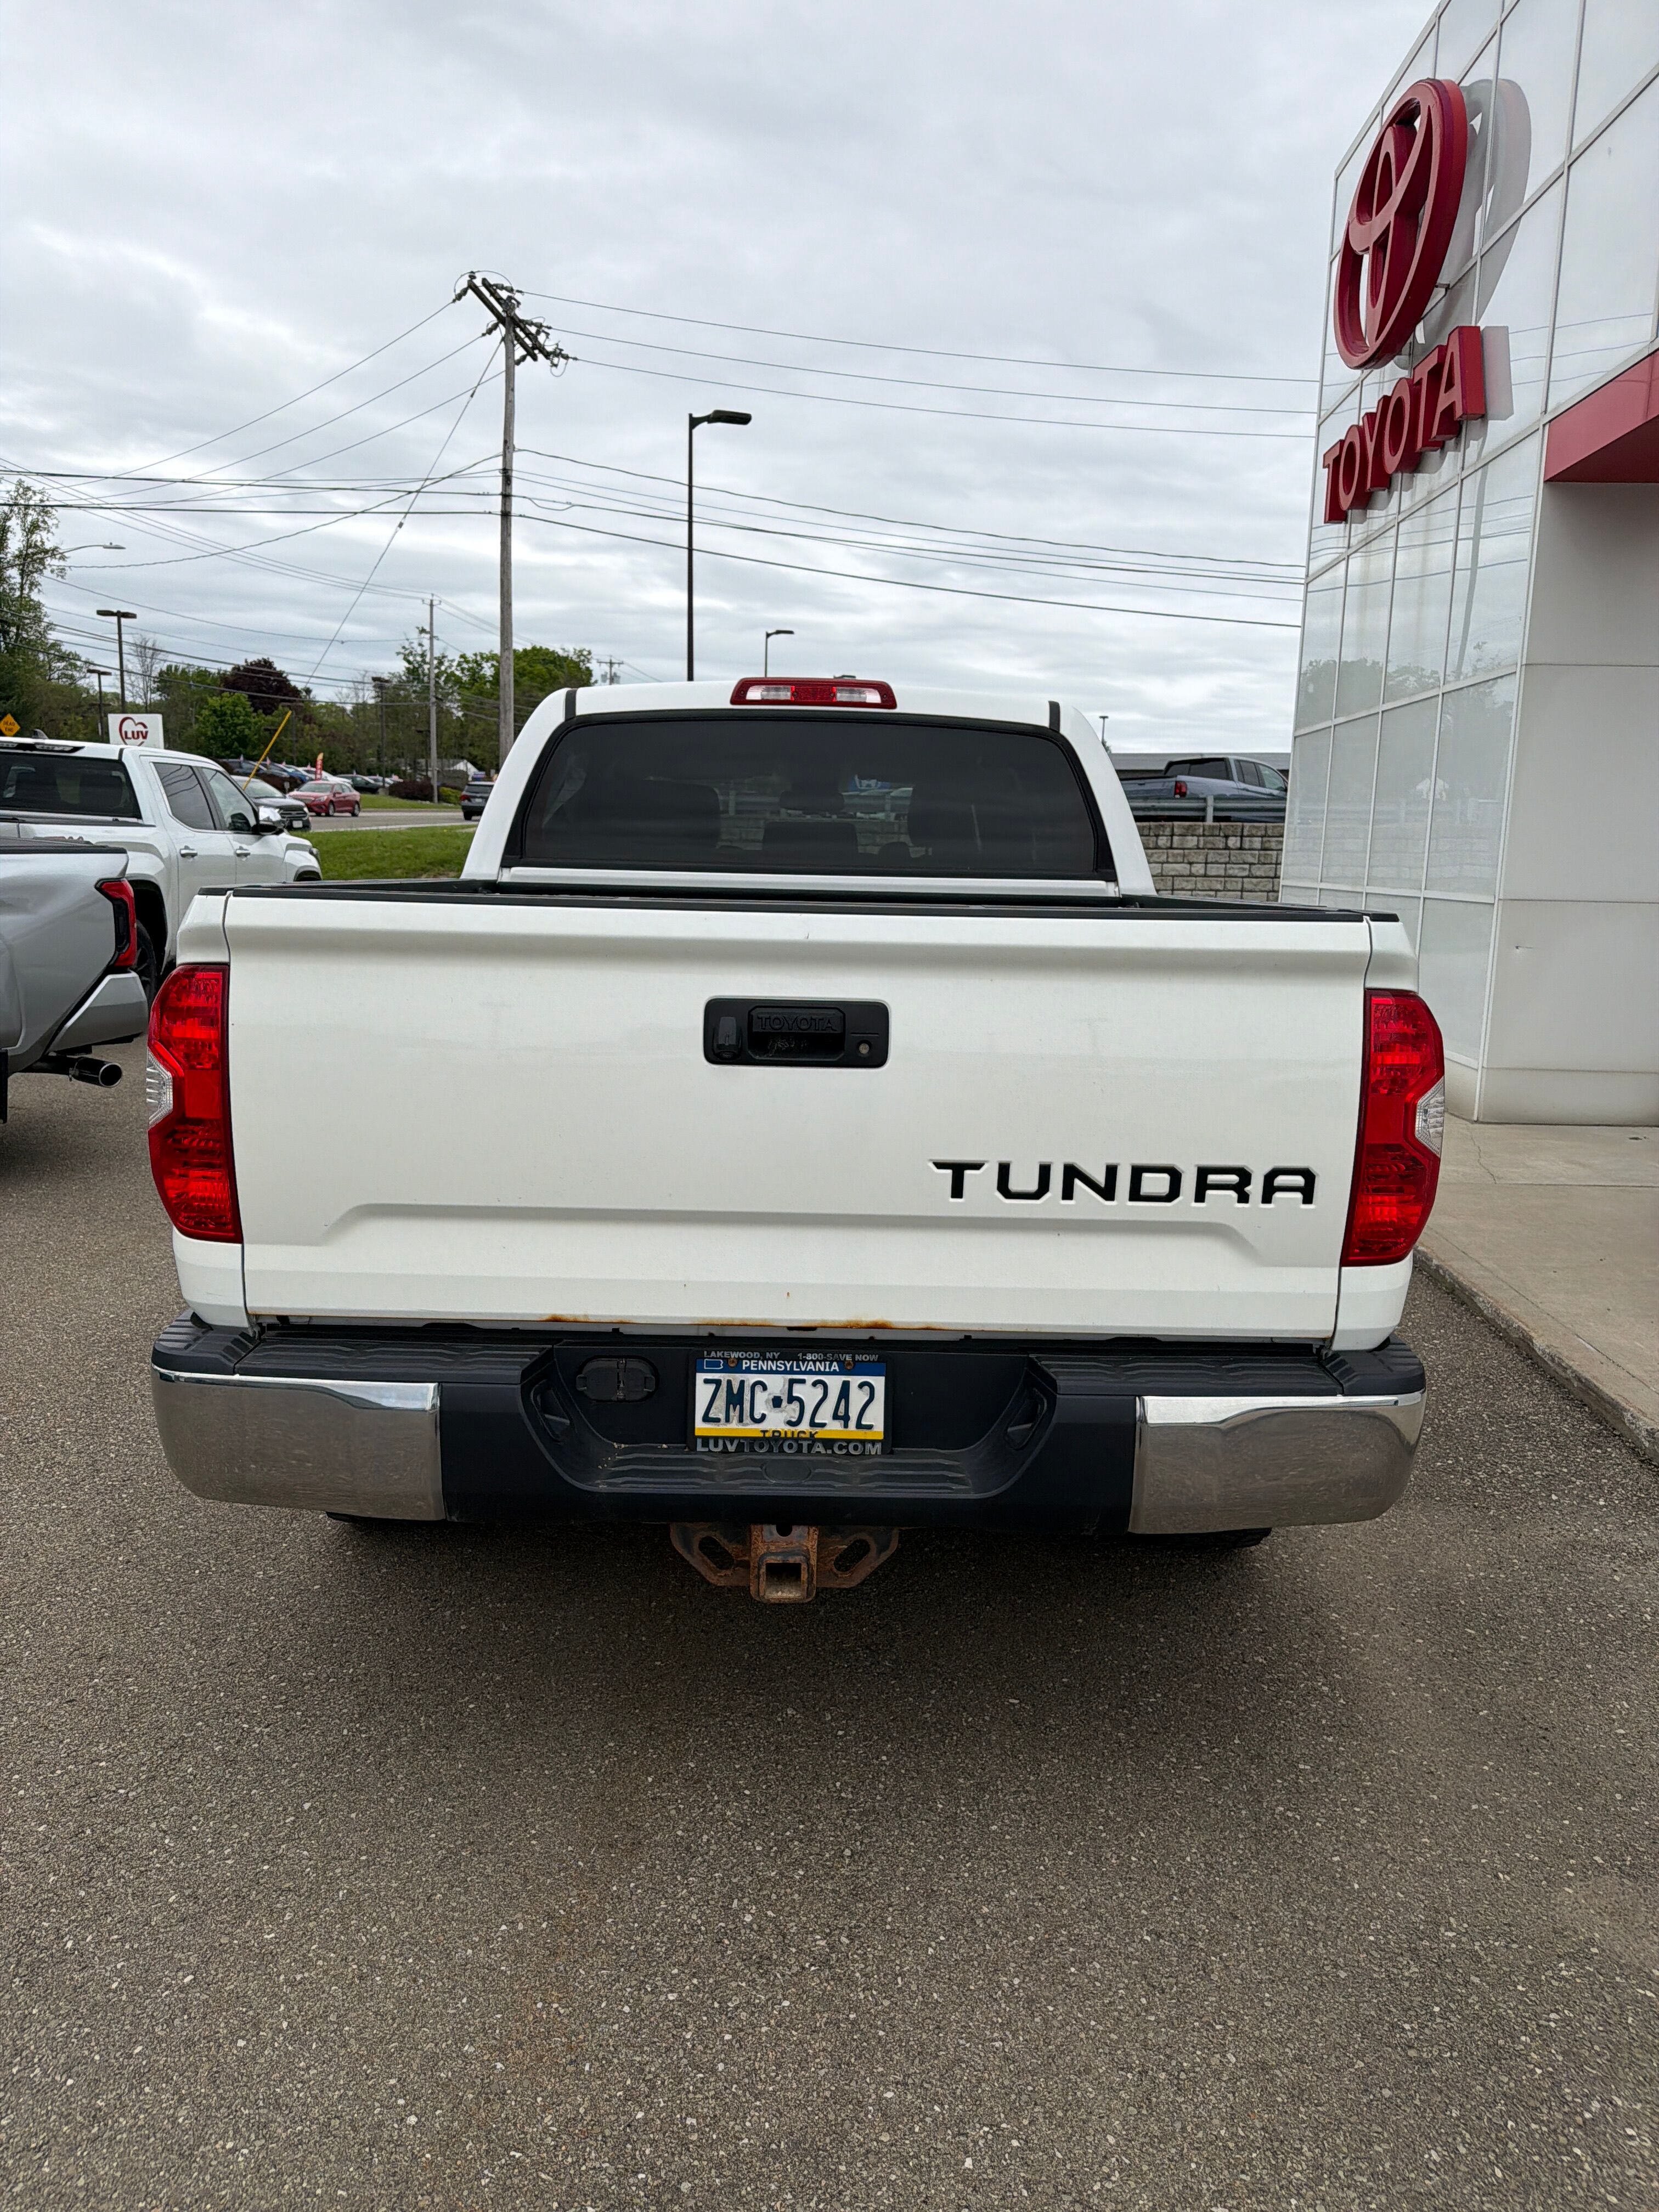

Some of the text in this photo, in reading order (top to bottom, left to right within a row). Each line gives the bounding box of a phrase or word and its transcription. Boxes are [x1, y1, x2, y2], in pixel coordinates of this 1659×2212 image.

[1323, 325, 1485, 524] TOYOTA
[124, 730, 149, 740] LUV
[757, 1015, 837, 1031] TOYOTA
[929, 1160, 1318, 1206] TUNDRA
[704, 1351, 763, 1359] LAKEWOOD,
[742, 1361, 839, 1372] PENNSYLVANIA
[696, 1438, 882, 1455] LUVTOYOTA.COM
